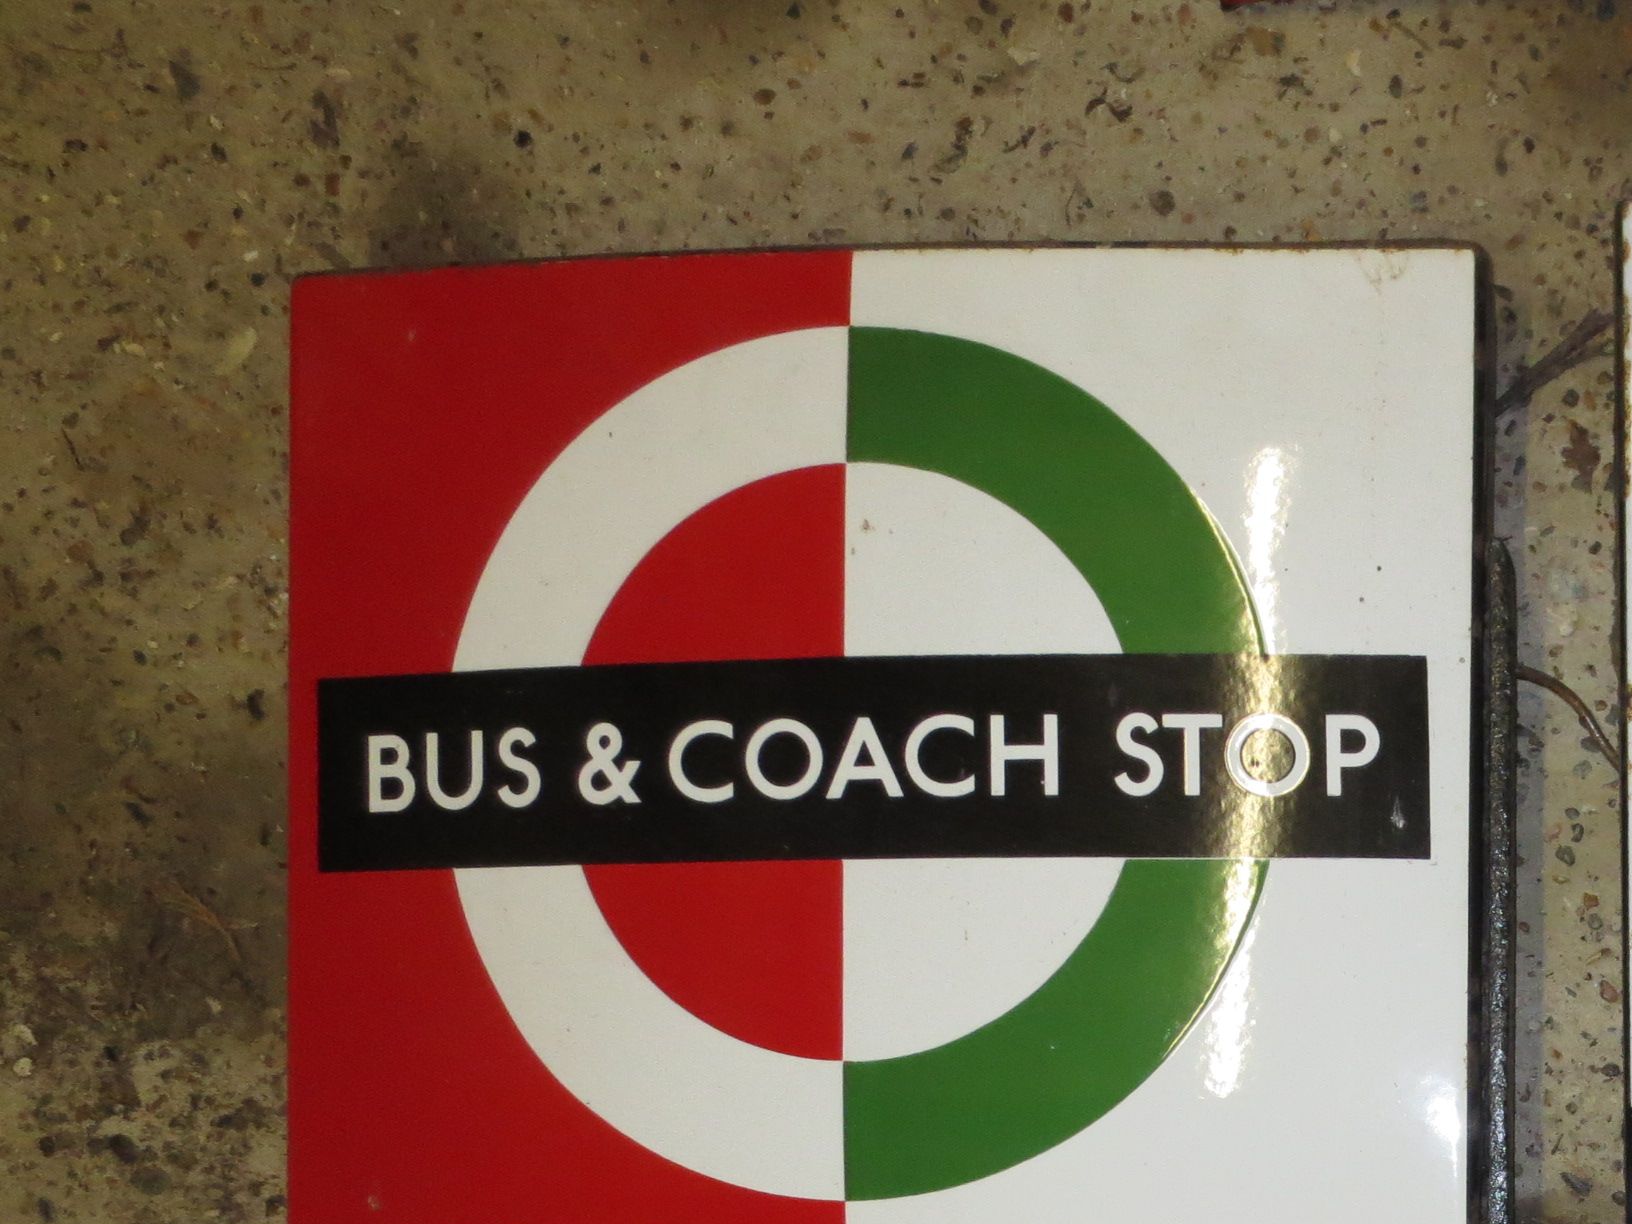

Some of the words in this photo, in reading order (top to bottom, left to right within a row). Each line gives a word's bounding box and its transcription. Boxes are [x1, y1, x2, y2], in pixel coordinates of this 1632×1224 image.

[366, 727, 542, 814] BUS
[577, 721, 642, 805] &
[667, 714, 1060, 804] COACH
[1114, 711, 1381, 799] STOP
